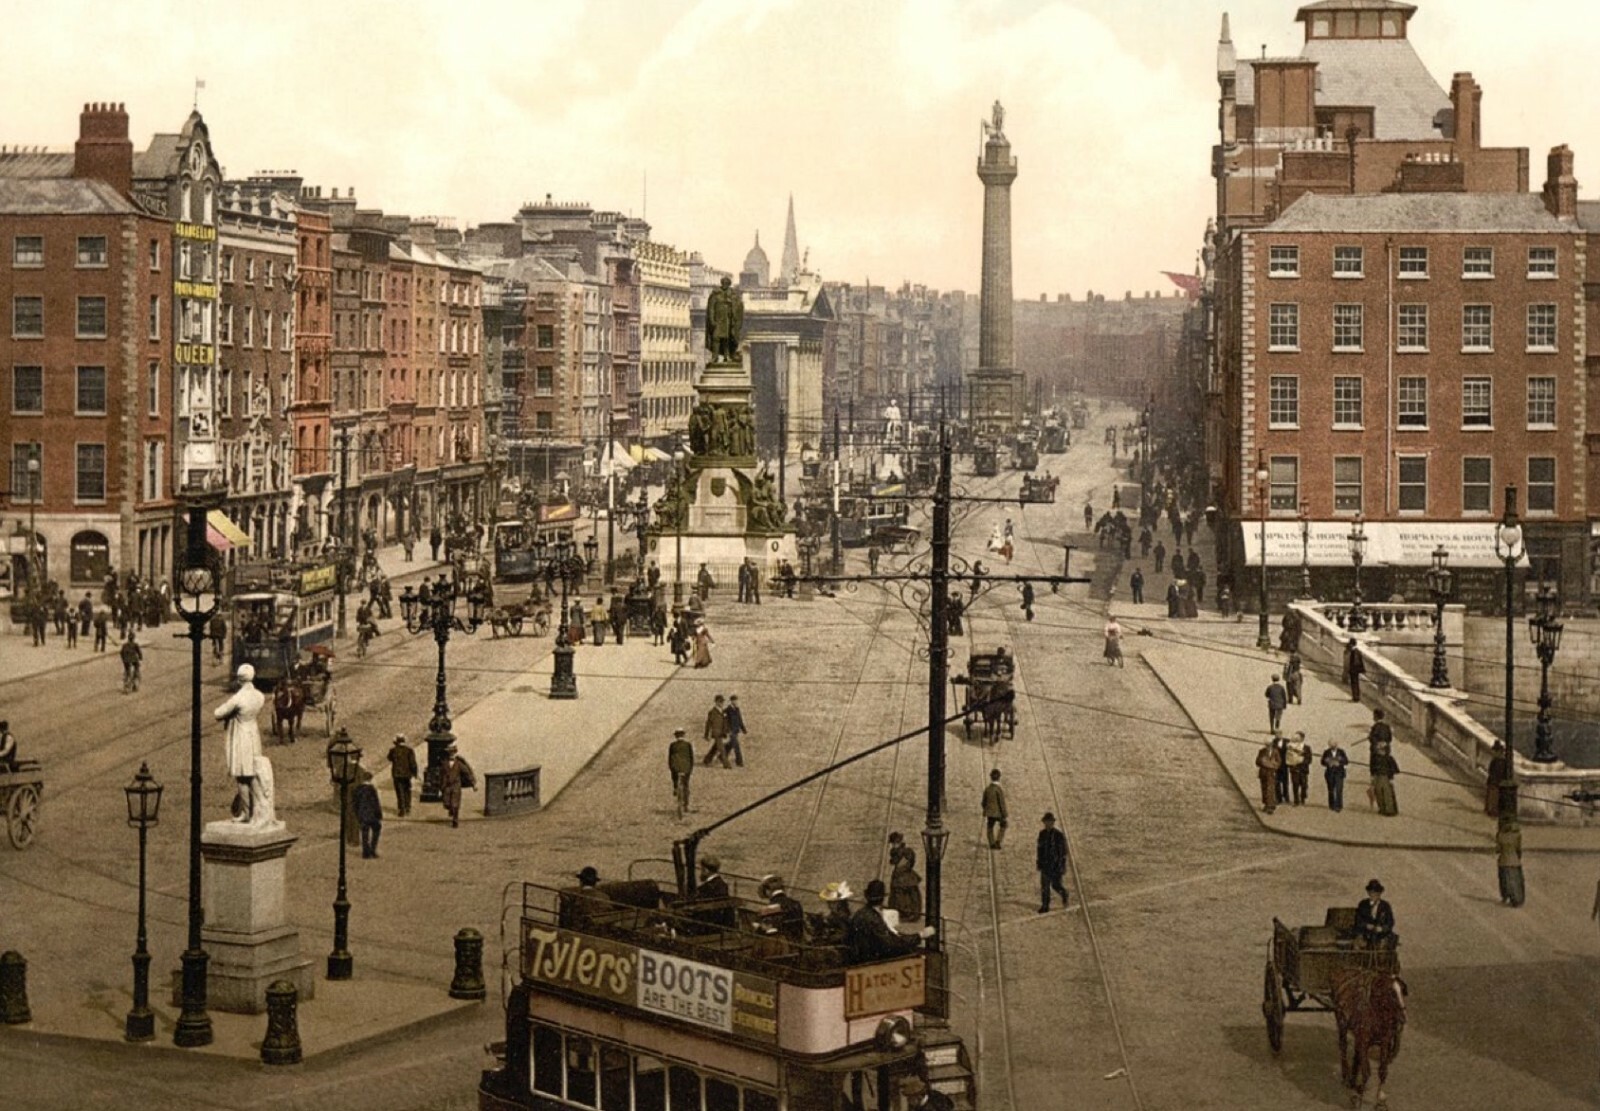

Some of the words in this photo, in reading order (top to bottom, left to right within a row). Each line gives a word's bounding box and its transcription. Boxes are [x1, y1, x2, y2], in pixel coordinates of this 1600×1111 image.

[175, 343, 214, 364] QUEEN
[530, 928, 637, 994] Tylers'
[642, 955, 729, 1005] BOOTS
[643, 988, 666, 1009] ARE
[671, 994, 693, 1015] THE
[697, 1002, 726, 1027] BEST
